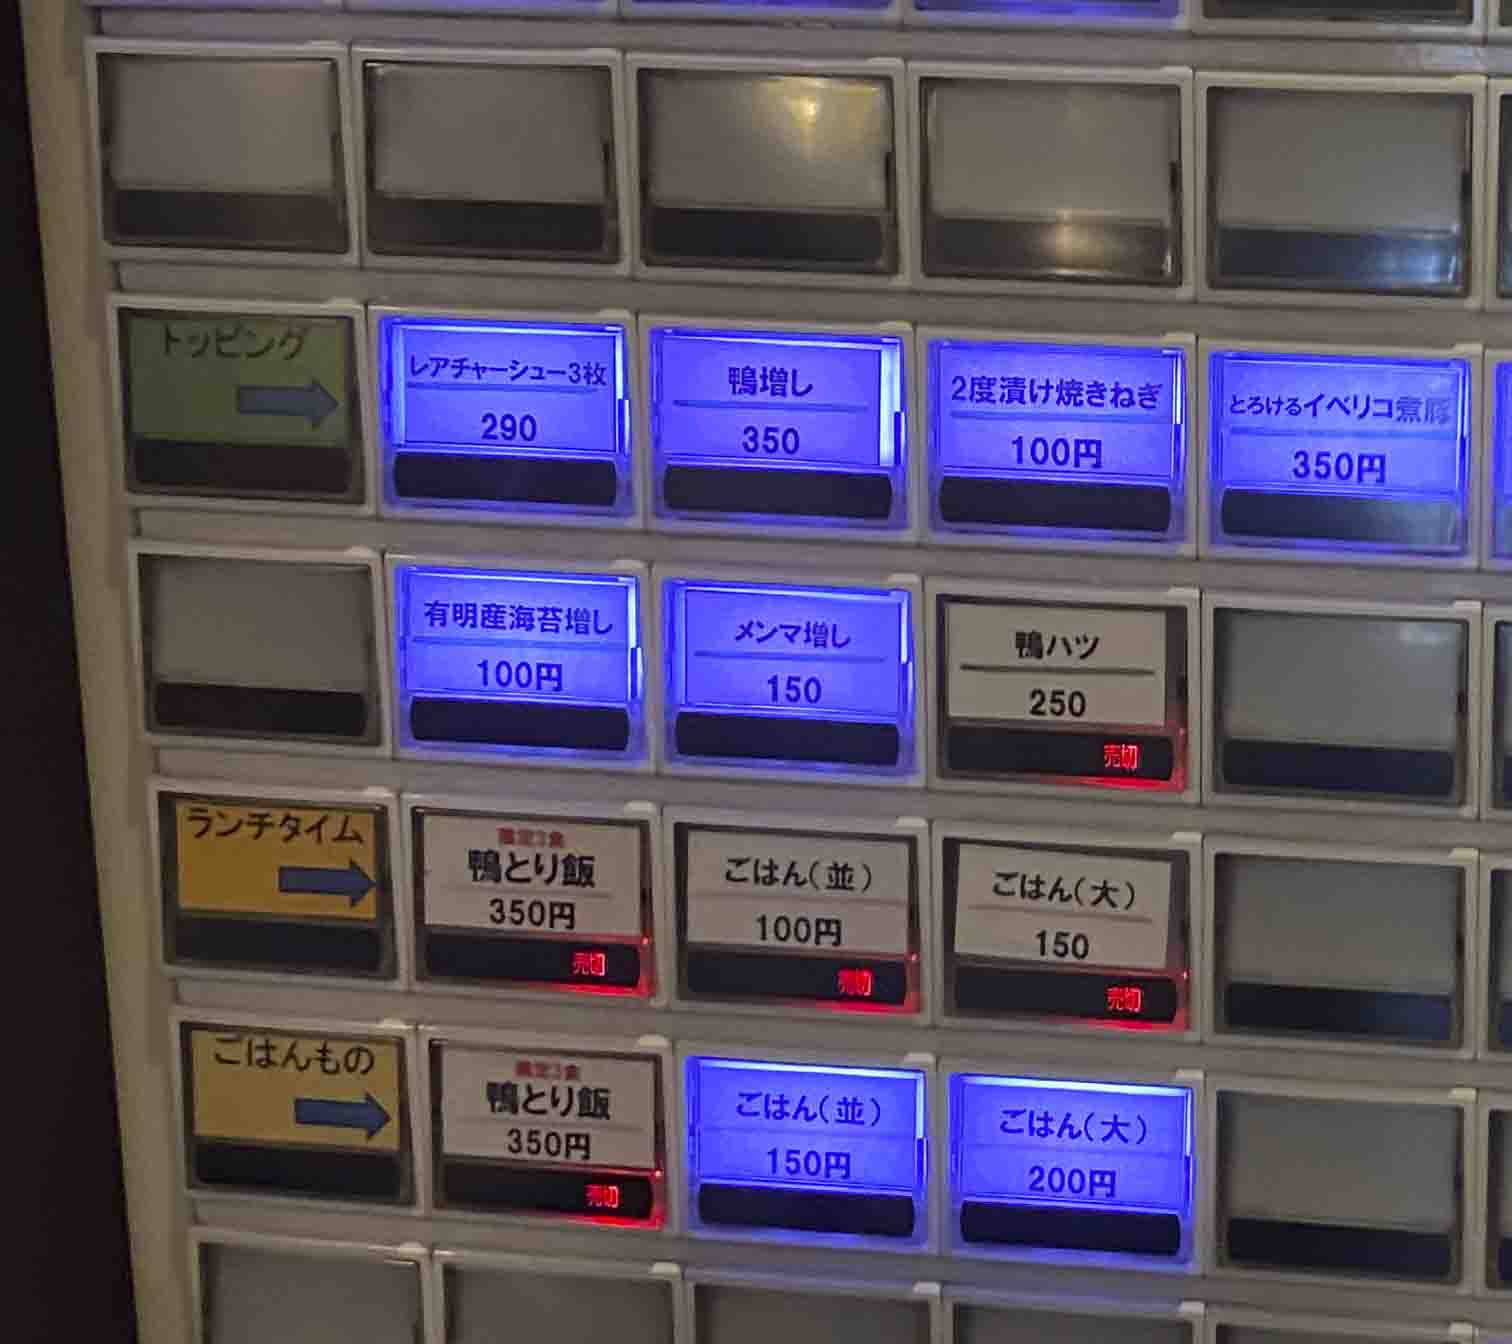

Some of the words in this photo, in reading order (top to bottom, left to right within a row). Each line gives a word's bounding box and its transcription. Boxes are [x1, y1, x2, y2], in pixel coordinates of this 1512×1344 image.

[164, 323, 308, 362] トッピング
[409, 353, 608, 386] レアチャーシュー3枚
[728, 365, 815, 399] 鴨増し
[951, 375, 1164, 411] 2度漬け焼きねぎ
[481, 412, 538, 442] 290
[742, 425, 801, 455] 350
[1011, 436, 1103, 470] 100円
[1293, 451, 1387, 484] 350円
[423, 601, 614, 636] 有明産海苔増し
[734, 621, 852, 650] メンマ増し
[1014, 631, 1101, 661] 鴨ハツ
[476, 660, 564, 693] 100円
[766, 675, 822, 705] 150
[1029, 688, 1087, 718] 250
[1103, 743, 1140, 771] 売切
[187, 810, 364, 845] ランチタイム
[468, 849, 595, 888] 鴨とり飯
[489, 898, 575, 930] 350円
[756, 914, 842, 947] 100円
[1035, 930, 1090, 960] 150
[1106, 985, 1143, 1013] 売切
[214, 1037, 376, 1076] ごはんもの
[486, 1080, 610, 1120] 鴨とり飯
[507, 1128, 591, 1160] 350円
[766, 1147, 851, 1179] 150円
[1028, 1166, 1117, 1199] 200円
